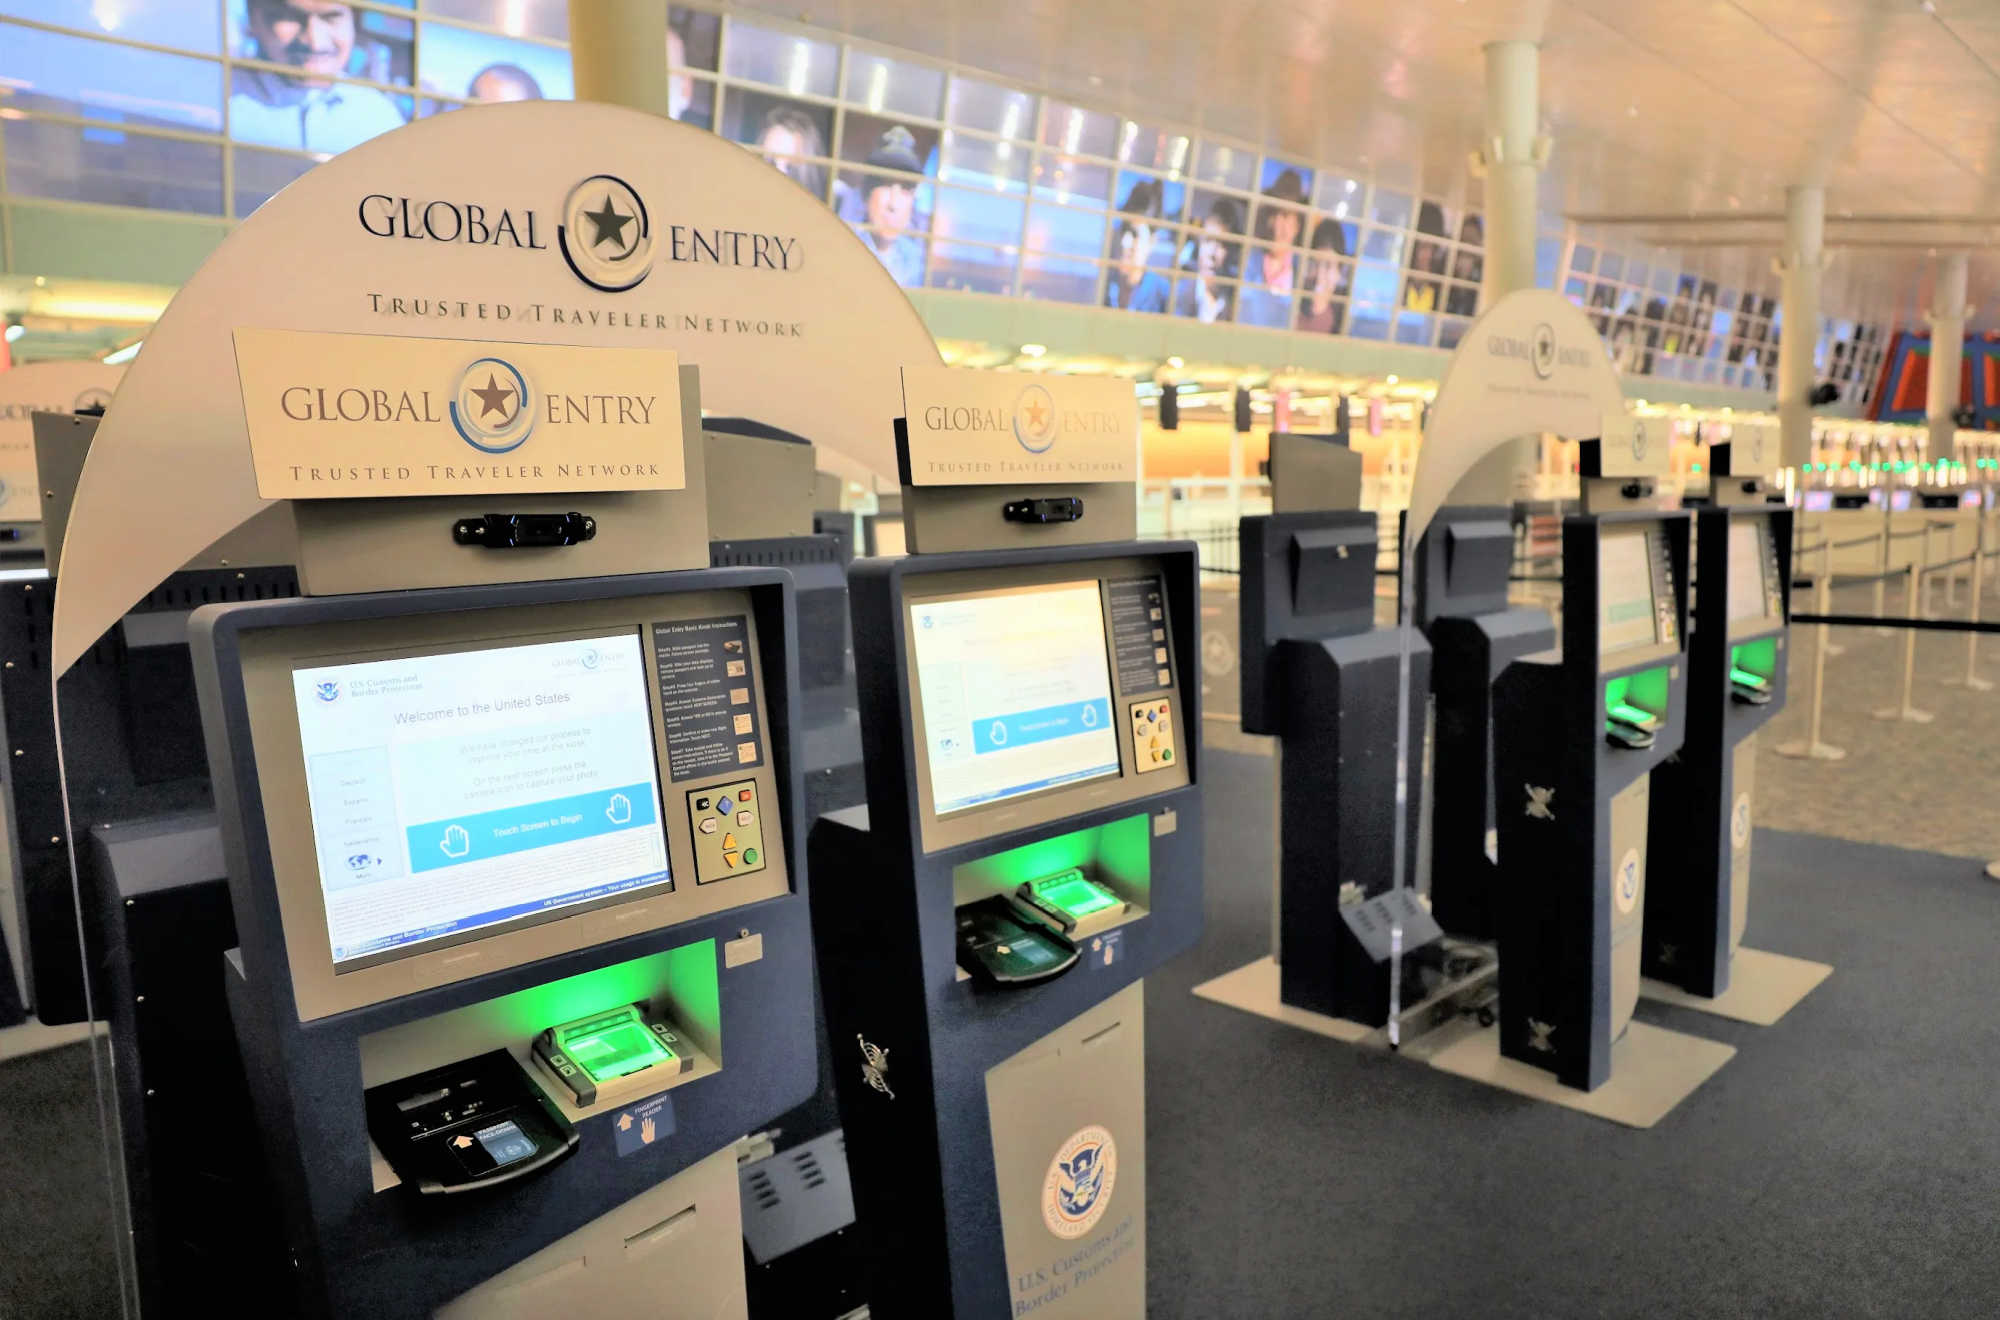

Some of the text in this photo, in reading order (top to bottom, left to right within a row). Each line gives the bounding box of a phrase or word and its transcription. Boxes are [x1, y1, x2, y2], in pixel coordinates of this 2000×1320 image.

[358, 194, 796, 271] GLOBAL ENTRY
[367, 293, 802, 337] TRUSTED TRAVELER NETWORK
[281, 387, 658, 425] GLOBAL ENTRY
[925, 406, 1121, 433] GLOBAL ENTRY
[288, 463, 660, 482] TRUSTED TRAVELER NETWORK
[928, 461, 991, 473] TRUSTED
[999, 461, 1061, 472] TRAVELER
[394, 691, 570, 725] Welcome to the United States
[493, 814, 583, 838] Touch Screen to Begin
[1052, 1237, 1111, 1276] Customs
[1015, 1283, 1067, 1317] Border
